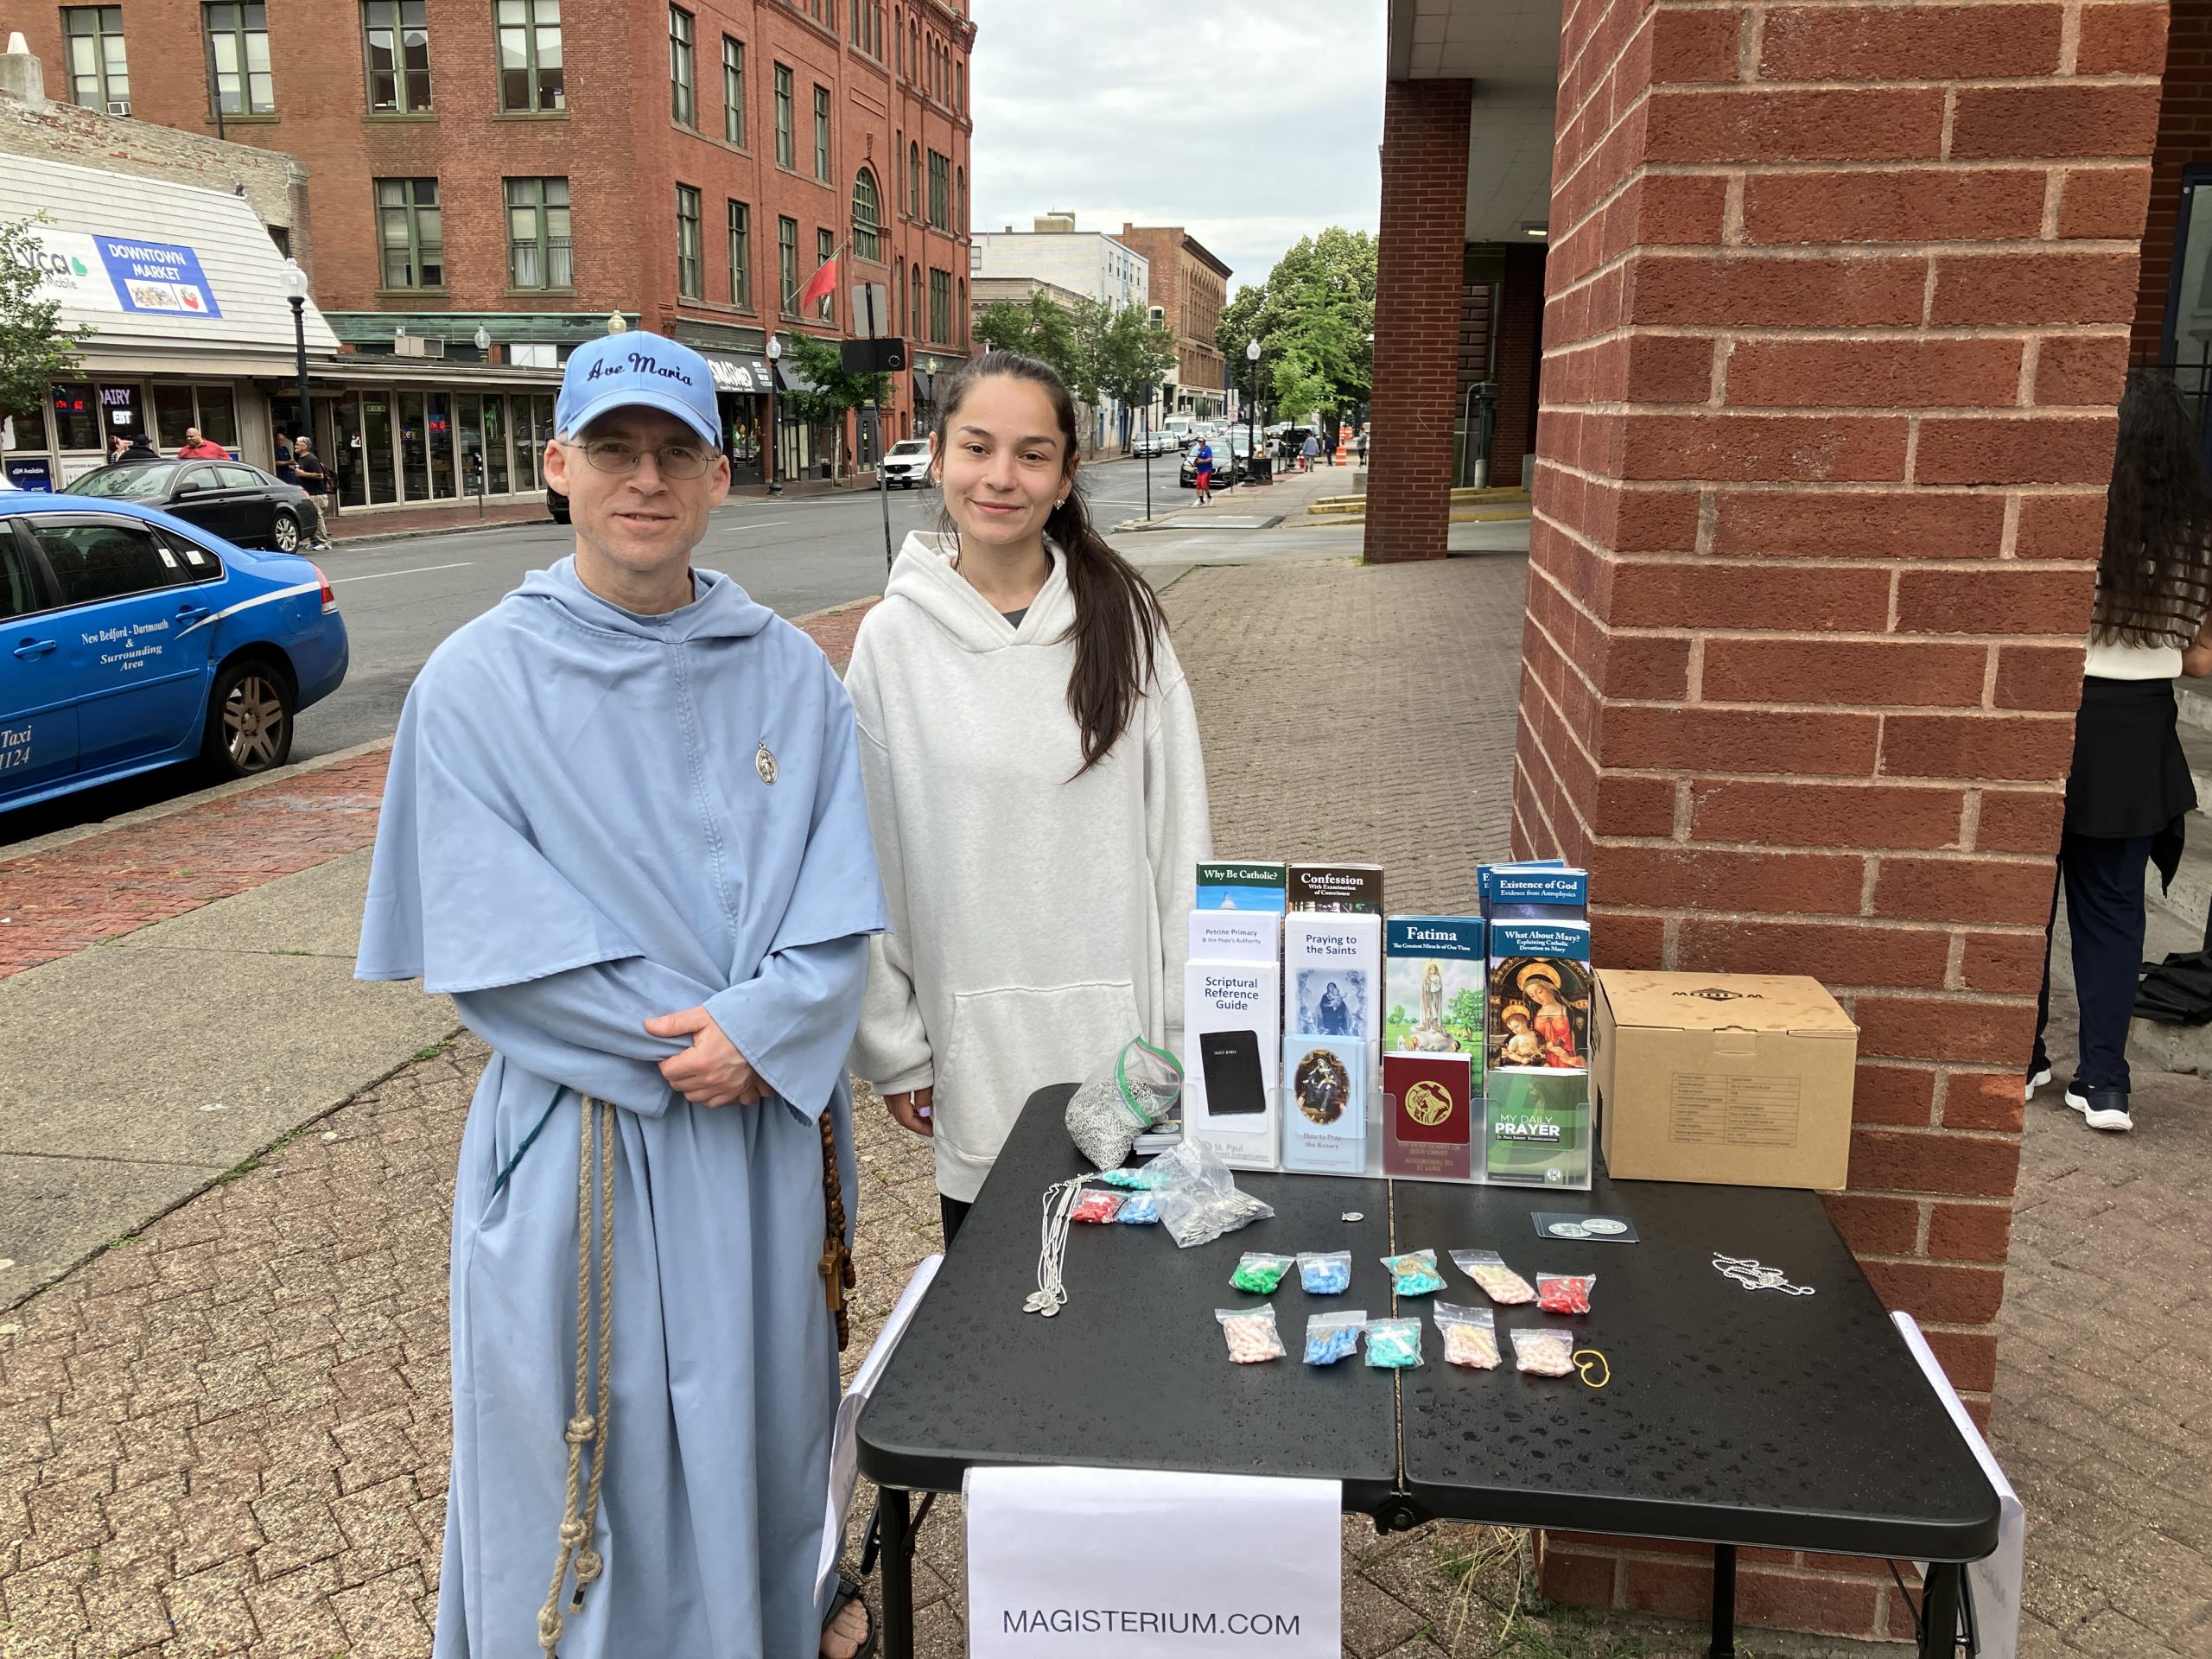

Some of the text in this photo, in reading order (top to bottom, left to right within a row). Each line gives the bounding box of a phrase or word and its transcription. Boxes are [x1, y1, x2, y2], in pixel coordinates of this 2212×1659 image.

[108, 243, 186, 265] DOWNTOWN
[133, 264, 181, 281] MARKET
[45, 274, 78, 289] Mobile
[587, 353, 693, 386] Ave Maria
[112, 410, 133, 424] EBT
[81, 632, 98, 645] New
[99, 626, 127, 642] Bedford
[133, 619, 168, 635] Dartmouth
[125, 639, 135, 648] &
[100, 645, 162, 664] Surrounding
[120, 660, 143, 671] Area
[1, 724, 32, 748] Taxi
[1205, 869, 1278, 881] Why Be Catholic?
[1300, 873, 1364, 887] Confession
[1500, 880, 1543, 890] Existence
[1545, 880, 1556, 889] of
[1556, 880, 1578, 890] God
[1306, 934, 1357, 946] Praying to
[1407, 926, 1457, 941] Fatima
[1505, 931, 1580, 944] What About Mary?
[1306, 945, 1357, 955] the Saints
[1205, 976, 1258, 988] Scriptural
[1205, 988, 1259, 1000] Reference
[1216, 1000, 1248, 1010] Guide
[1500, 1114, 1553, 1125] MY DAILY
[1495, 1122, 1560, 1137] PRAYER
[1214, 1143, 1243, 1153] St. Paul
[1317, 1141, 1339, 1150] Rosary
[1003, 1609, 1300, 1637] MAGISTERIUM.COM
